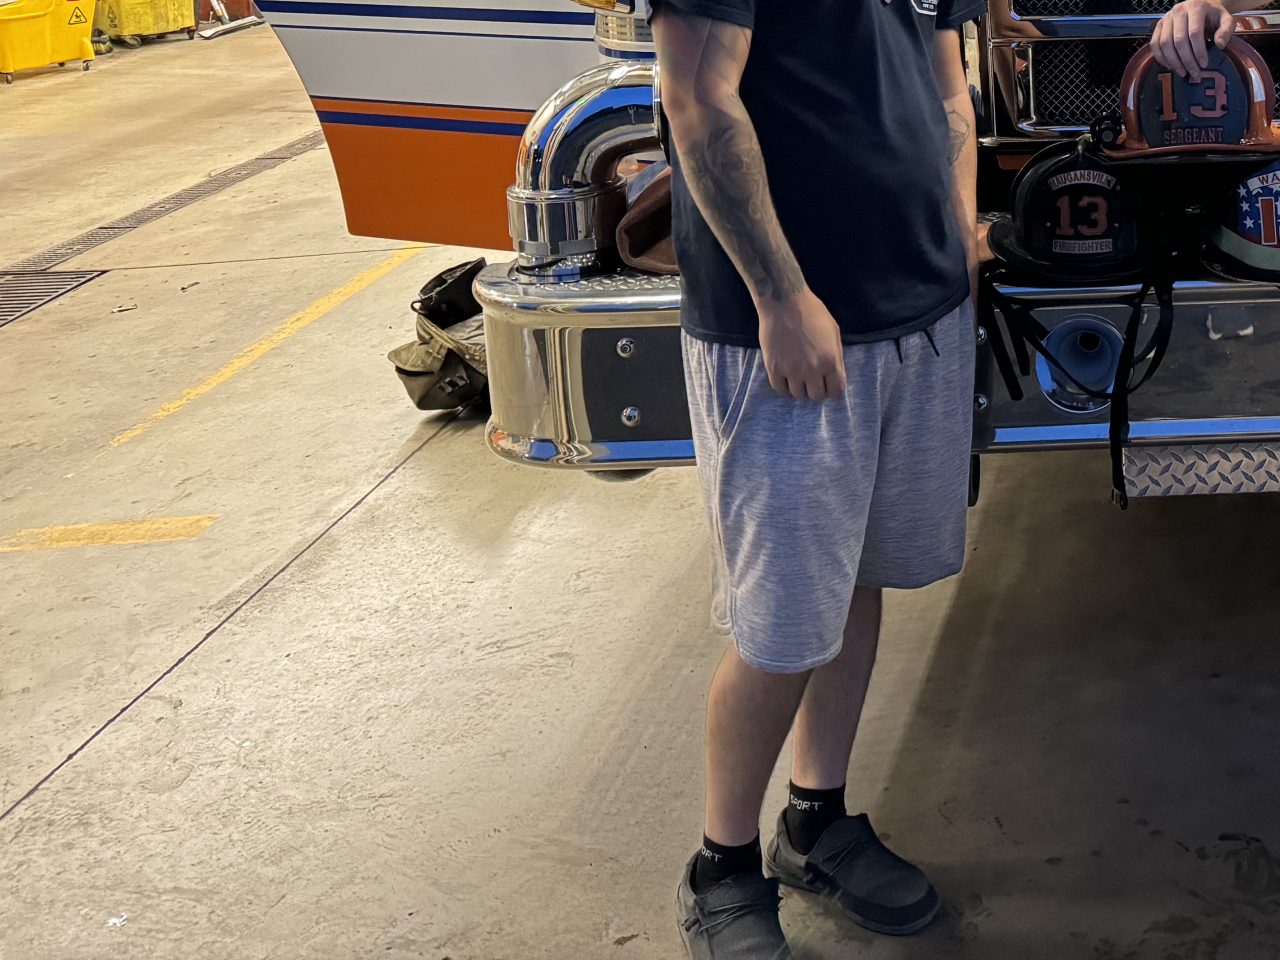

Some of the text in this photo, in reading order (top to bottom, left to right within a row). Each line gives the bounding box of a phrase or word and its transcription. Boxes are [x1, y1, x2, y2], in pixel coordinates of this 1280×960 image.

[1157, 71, 1228, 121] 13
[1164, 127, 1223, 144] SERGEANT
[1055, 195, 1108, 236] 13
[1054, 240, 1112, 252] FIREFIGHTER
[790, 794, 823, 811] SPORT
[701, 846, 723, 863] ORT
